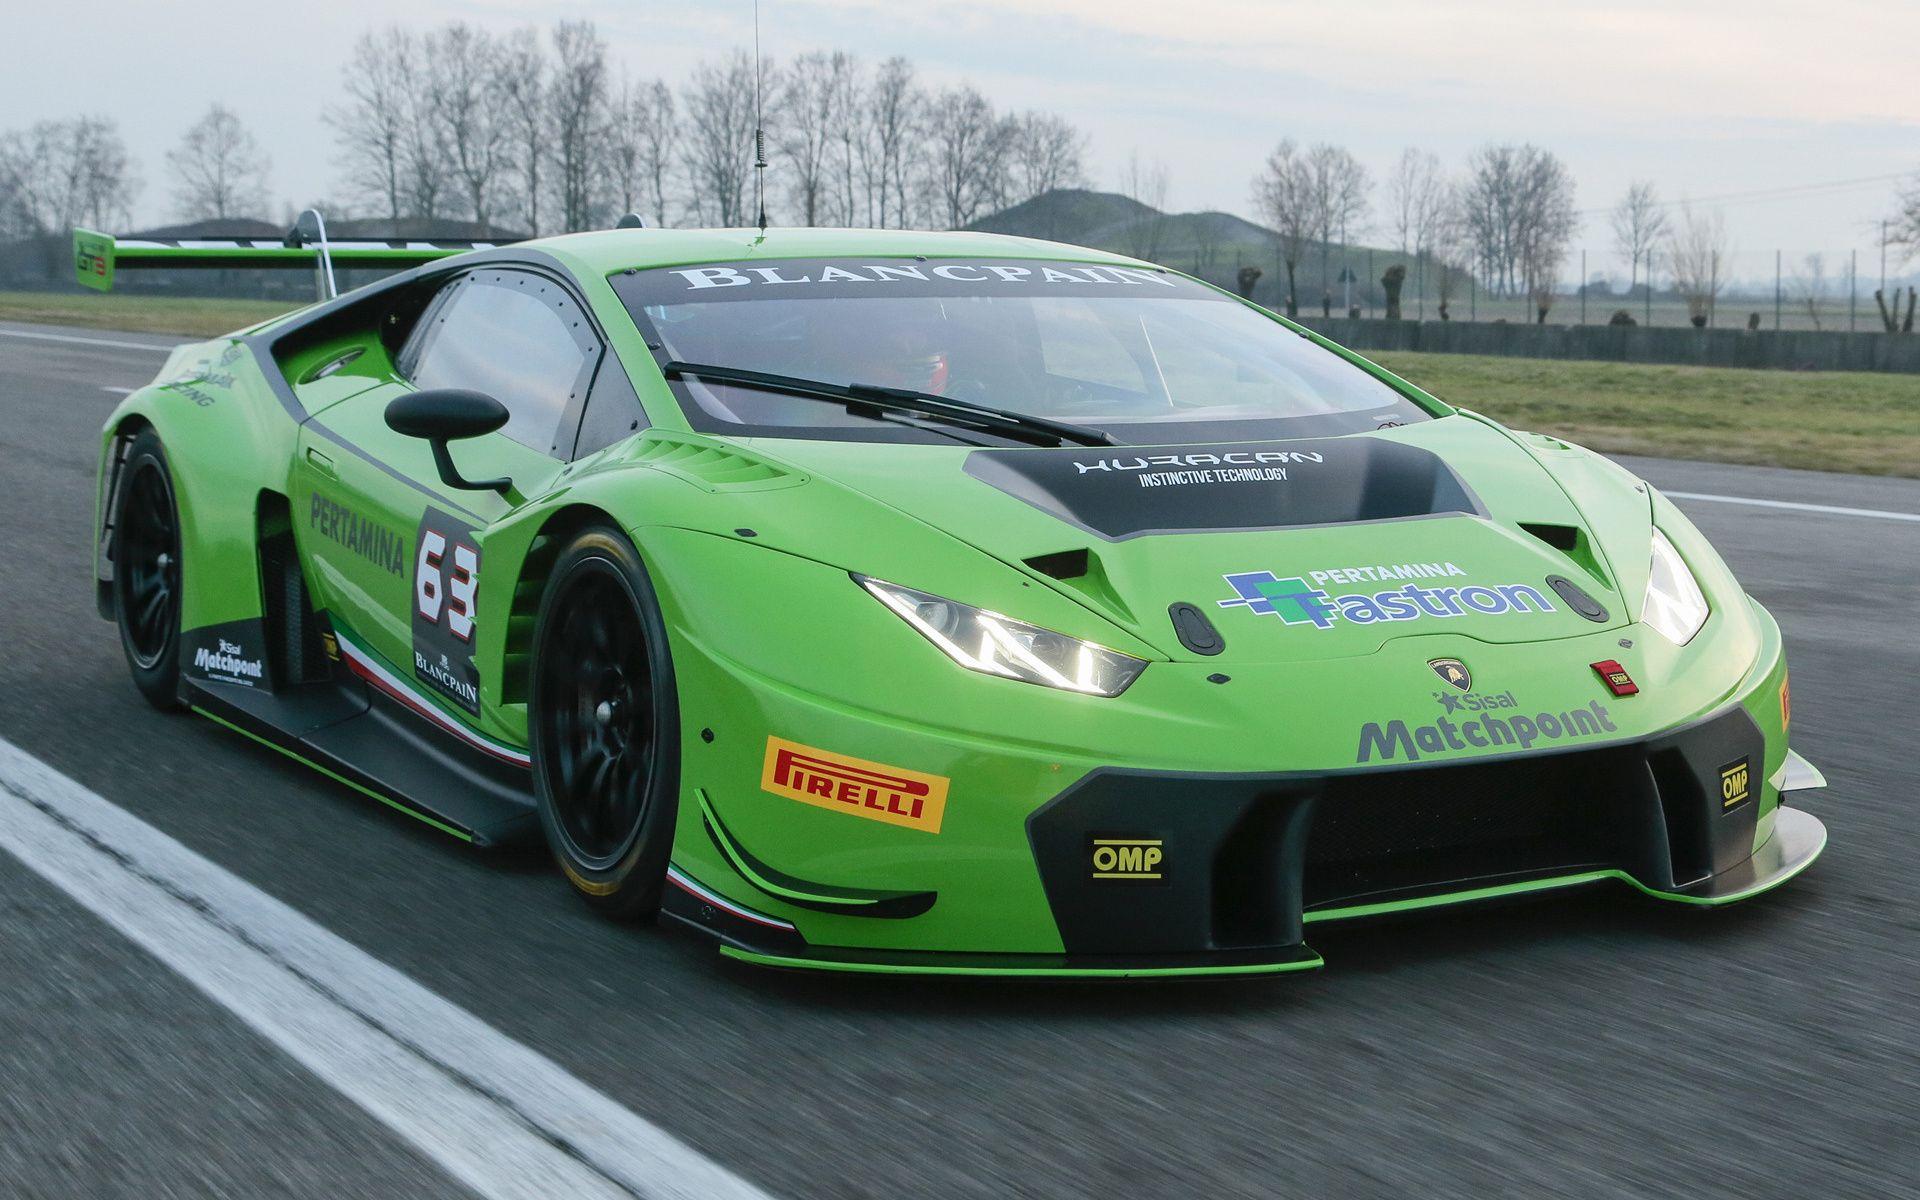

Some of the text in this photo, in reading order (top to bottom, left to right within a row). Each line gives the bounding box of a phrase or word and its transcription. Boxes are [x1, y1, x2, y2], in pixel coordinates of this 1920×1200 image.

[668, 264, 1176, 290] BLANCPAIN
[1138, 467, 1288, 488] INSTINCTIVE TECHNOLOGY
[310, 491, 404, 579] PERTAMINA
[416, 529, 479, 643] 63
[1308, 561, 1467, 586] PERTAMINA
[1290, 582, 1557, 630] Fastron
[194, 647, 262, 678] Matchpoint
[415, 651, 477, 703] BLANCPAIN
[1463, 690, 1518, 711] Sisal
[1356, 699, 1618, 763] Matchpoint
[773, 748, 930, 819] PIRELLI
[1723, 770, 1748, 799] OMP
[1093, 846, 1162, 872] OMP
